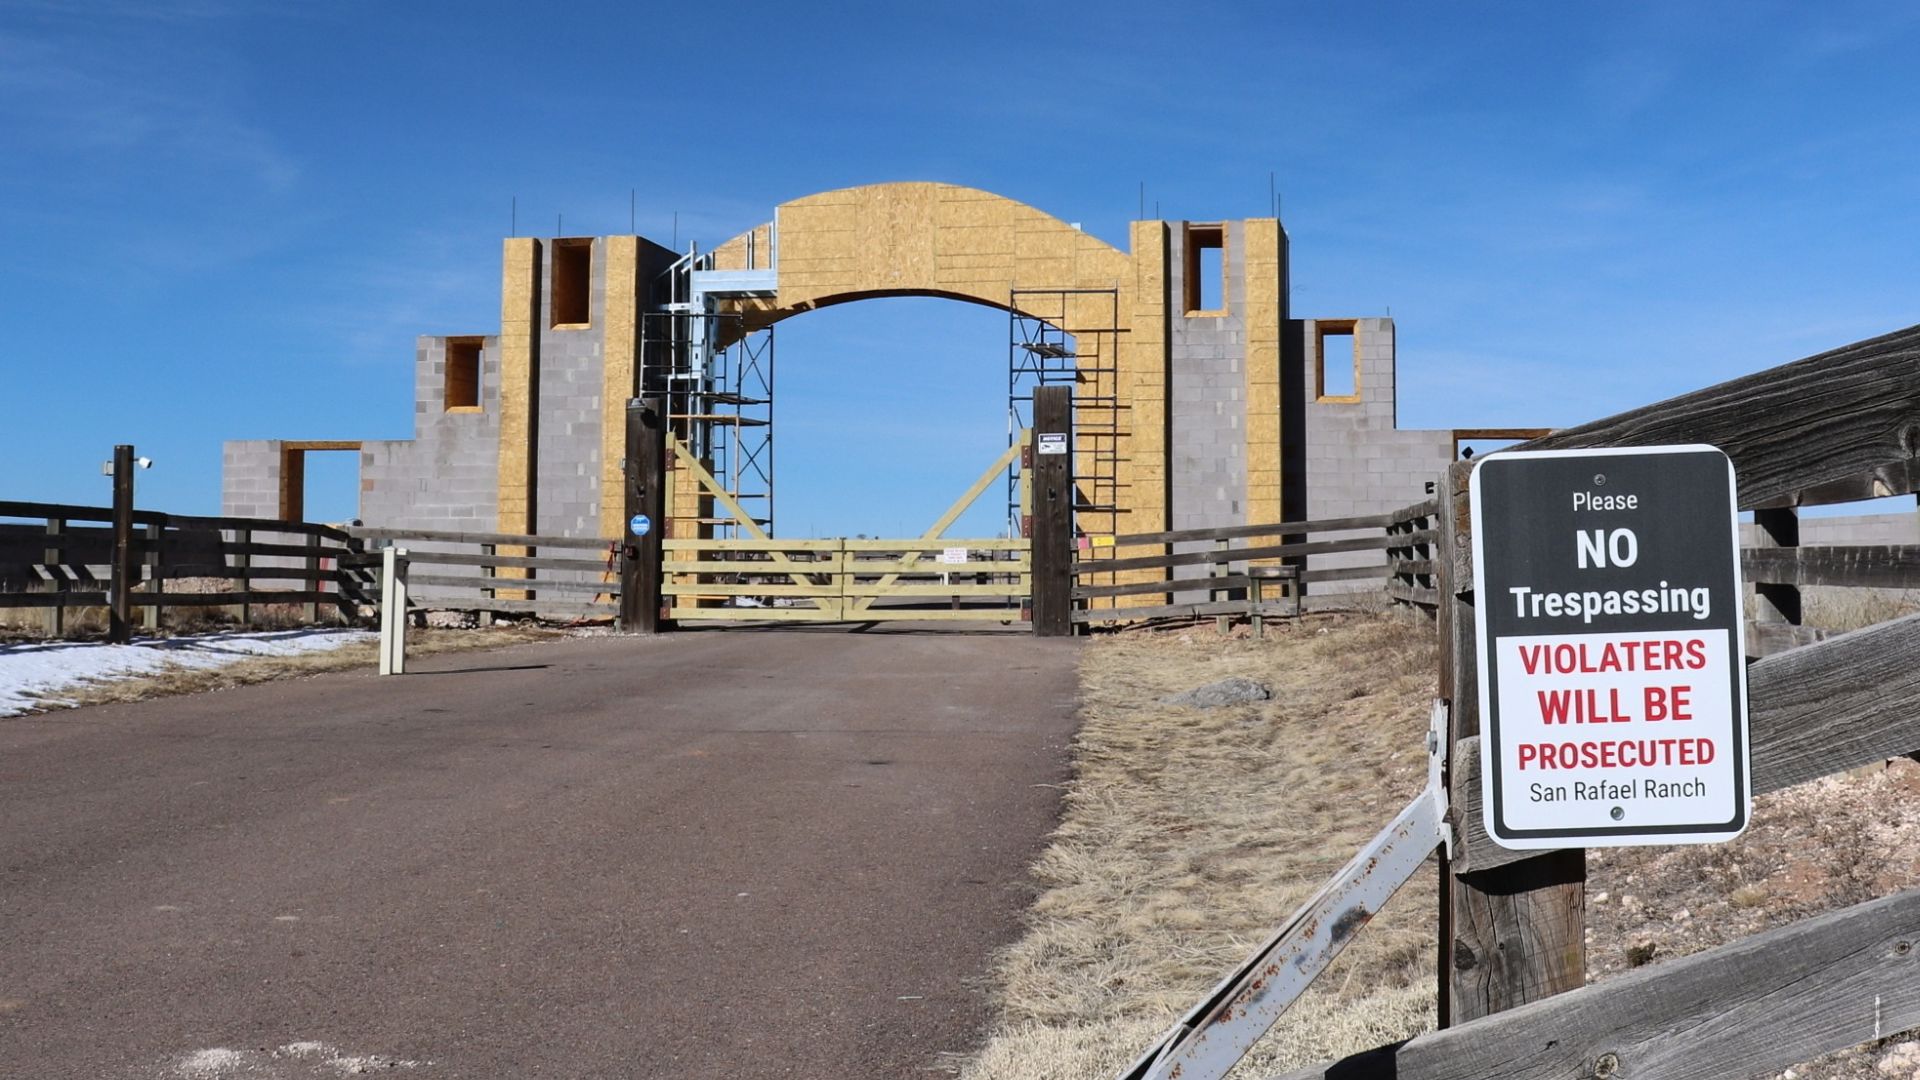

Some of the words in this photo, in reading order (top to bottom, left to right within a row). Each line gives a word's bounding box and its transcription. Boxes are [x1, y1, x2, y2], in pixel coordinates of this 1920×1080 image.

[1572, 491, 1638, 512] Please
[1576, 527, 1638, 569] NO
[1509, 580, 1711, 624] Trespassing
[1518, 639, 1707, 675] VIOLATERS
[1537, 687, 1631, 725] WILL
[1644, 685, 1693, 722] BE
[1518, 737, 1716, 771] PROSECUTED
[1529, 782, 1567, 802] San
[1574, 779, 1637, 801] Rafael
[1645, 777, 1706, 798] Ranch
